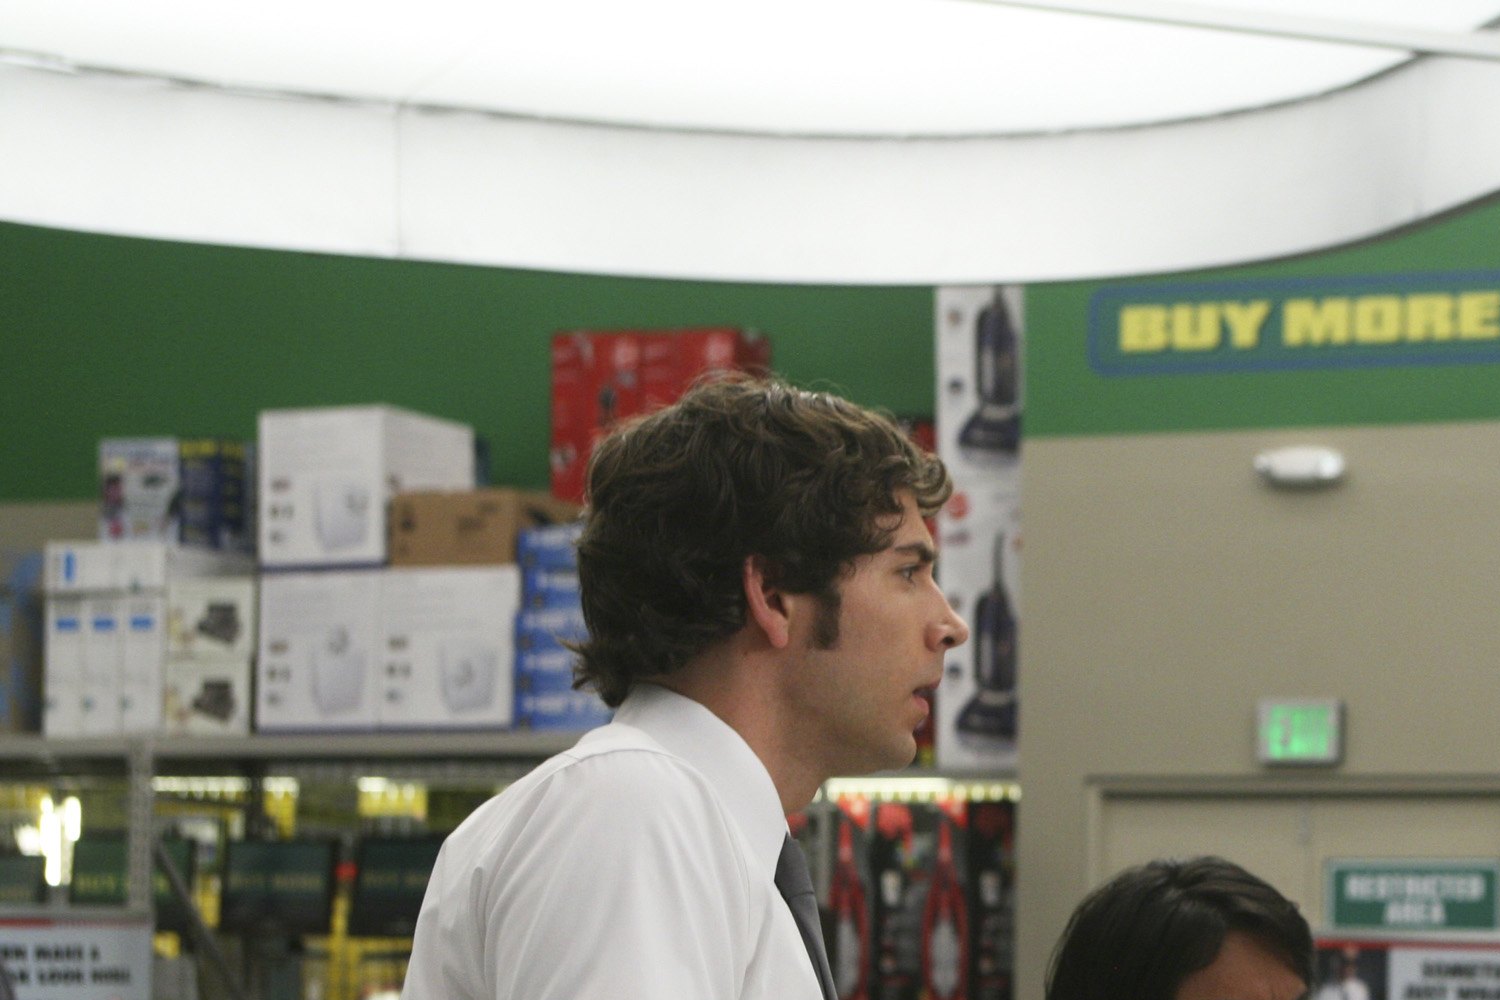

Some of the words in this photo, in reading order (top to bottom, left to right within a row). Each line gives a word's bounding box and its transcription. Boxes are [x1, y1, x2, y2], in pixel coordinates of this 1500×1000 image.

[1118, 300, 1270, 353] BUY
[1344, 874, 1486, 899] RESTRICTED
[1384, 901, 1445, 924] AREA
